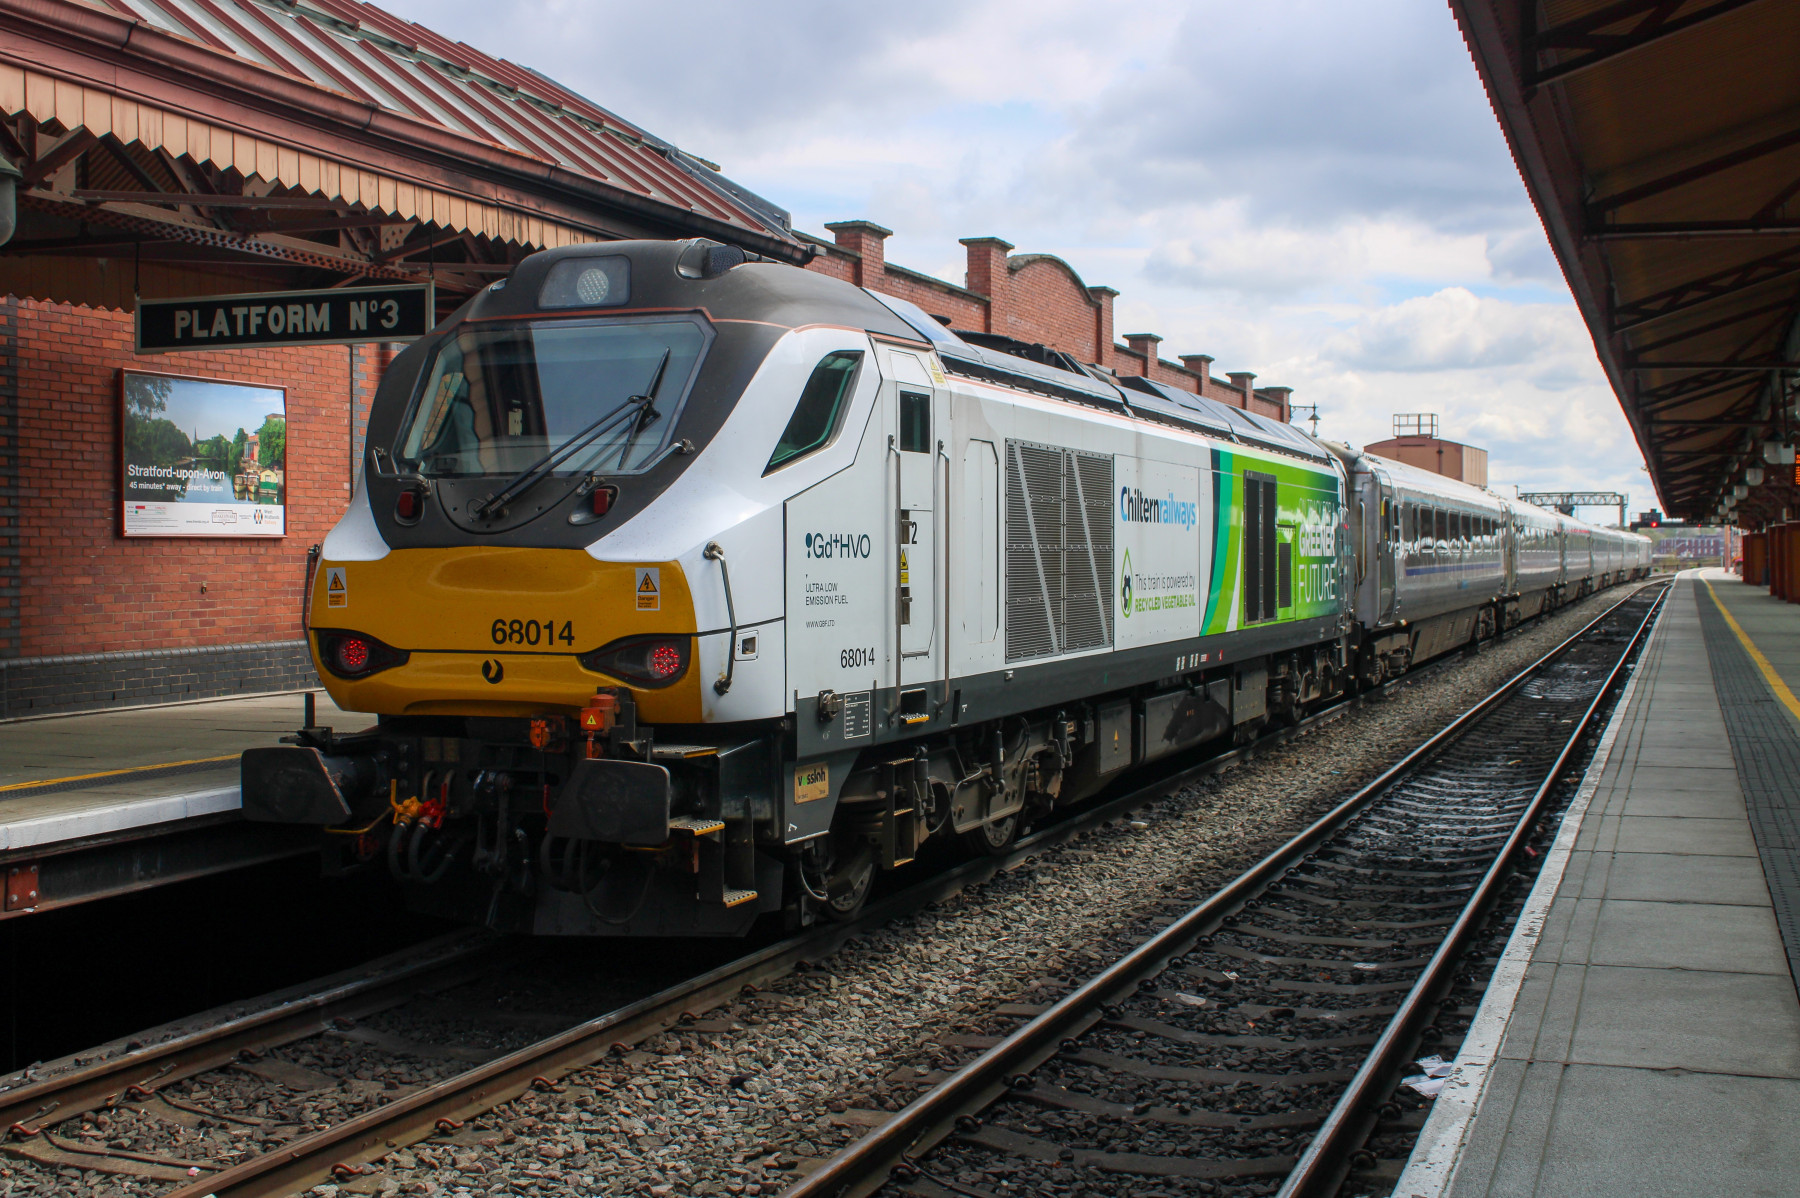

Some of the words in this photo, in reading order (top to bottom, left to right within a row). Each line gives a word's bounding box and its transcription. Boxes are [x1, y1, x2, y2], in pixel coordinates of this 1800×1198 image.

[174, 302, 330, 339] PLATFORM
[128, 464, 225, 480] Stratford-upon-Avon
[166, 484, 182, 492] away
[186, 483, 202, 491] direct
[203, 485, 209, 493] by
[911, 521, 918, 545] 2
[1299, 524, 1336, 556] GREENER
[805, 582, 824, 593] ULTRA
[825, 582, 838, 592] LOW
[1135, 573, 1147, 591] This
[1147, 573, 1161, 590] train
[1166, 571, 1189, 592] powered
[1189, 572, 1196, 590] by
[1298, 563, 1336, 604] FUTURE
[805, 595, 834, 606] EMISSION
[834, 594, 849, 605] FUEL
[1135, 596, 1161, 612] RECYCLED
[1161, 595, 1188, 610] VEGETABLE
[1188, 593, 1196, 607] OIL
[491, 619, 575, 647] 68014
[840, 647, 875, 669] 68014
